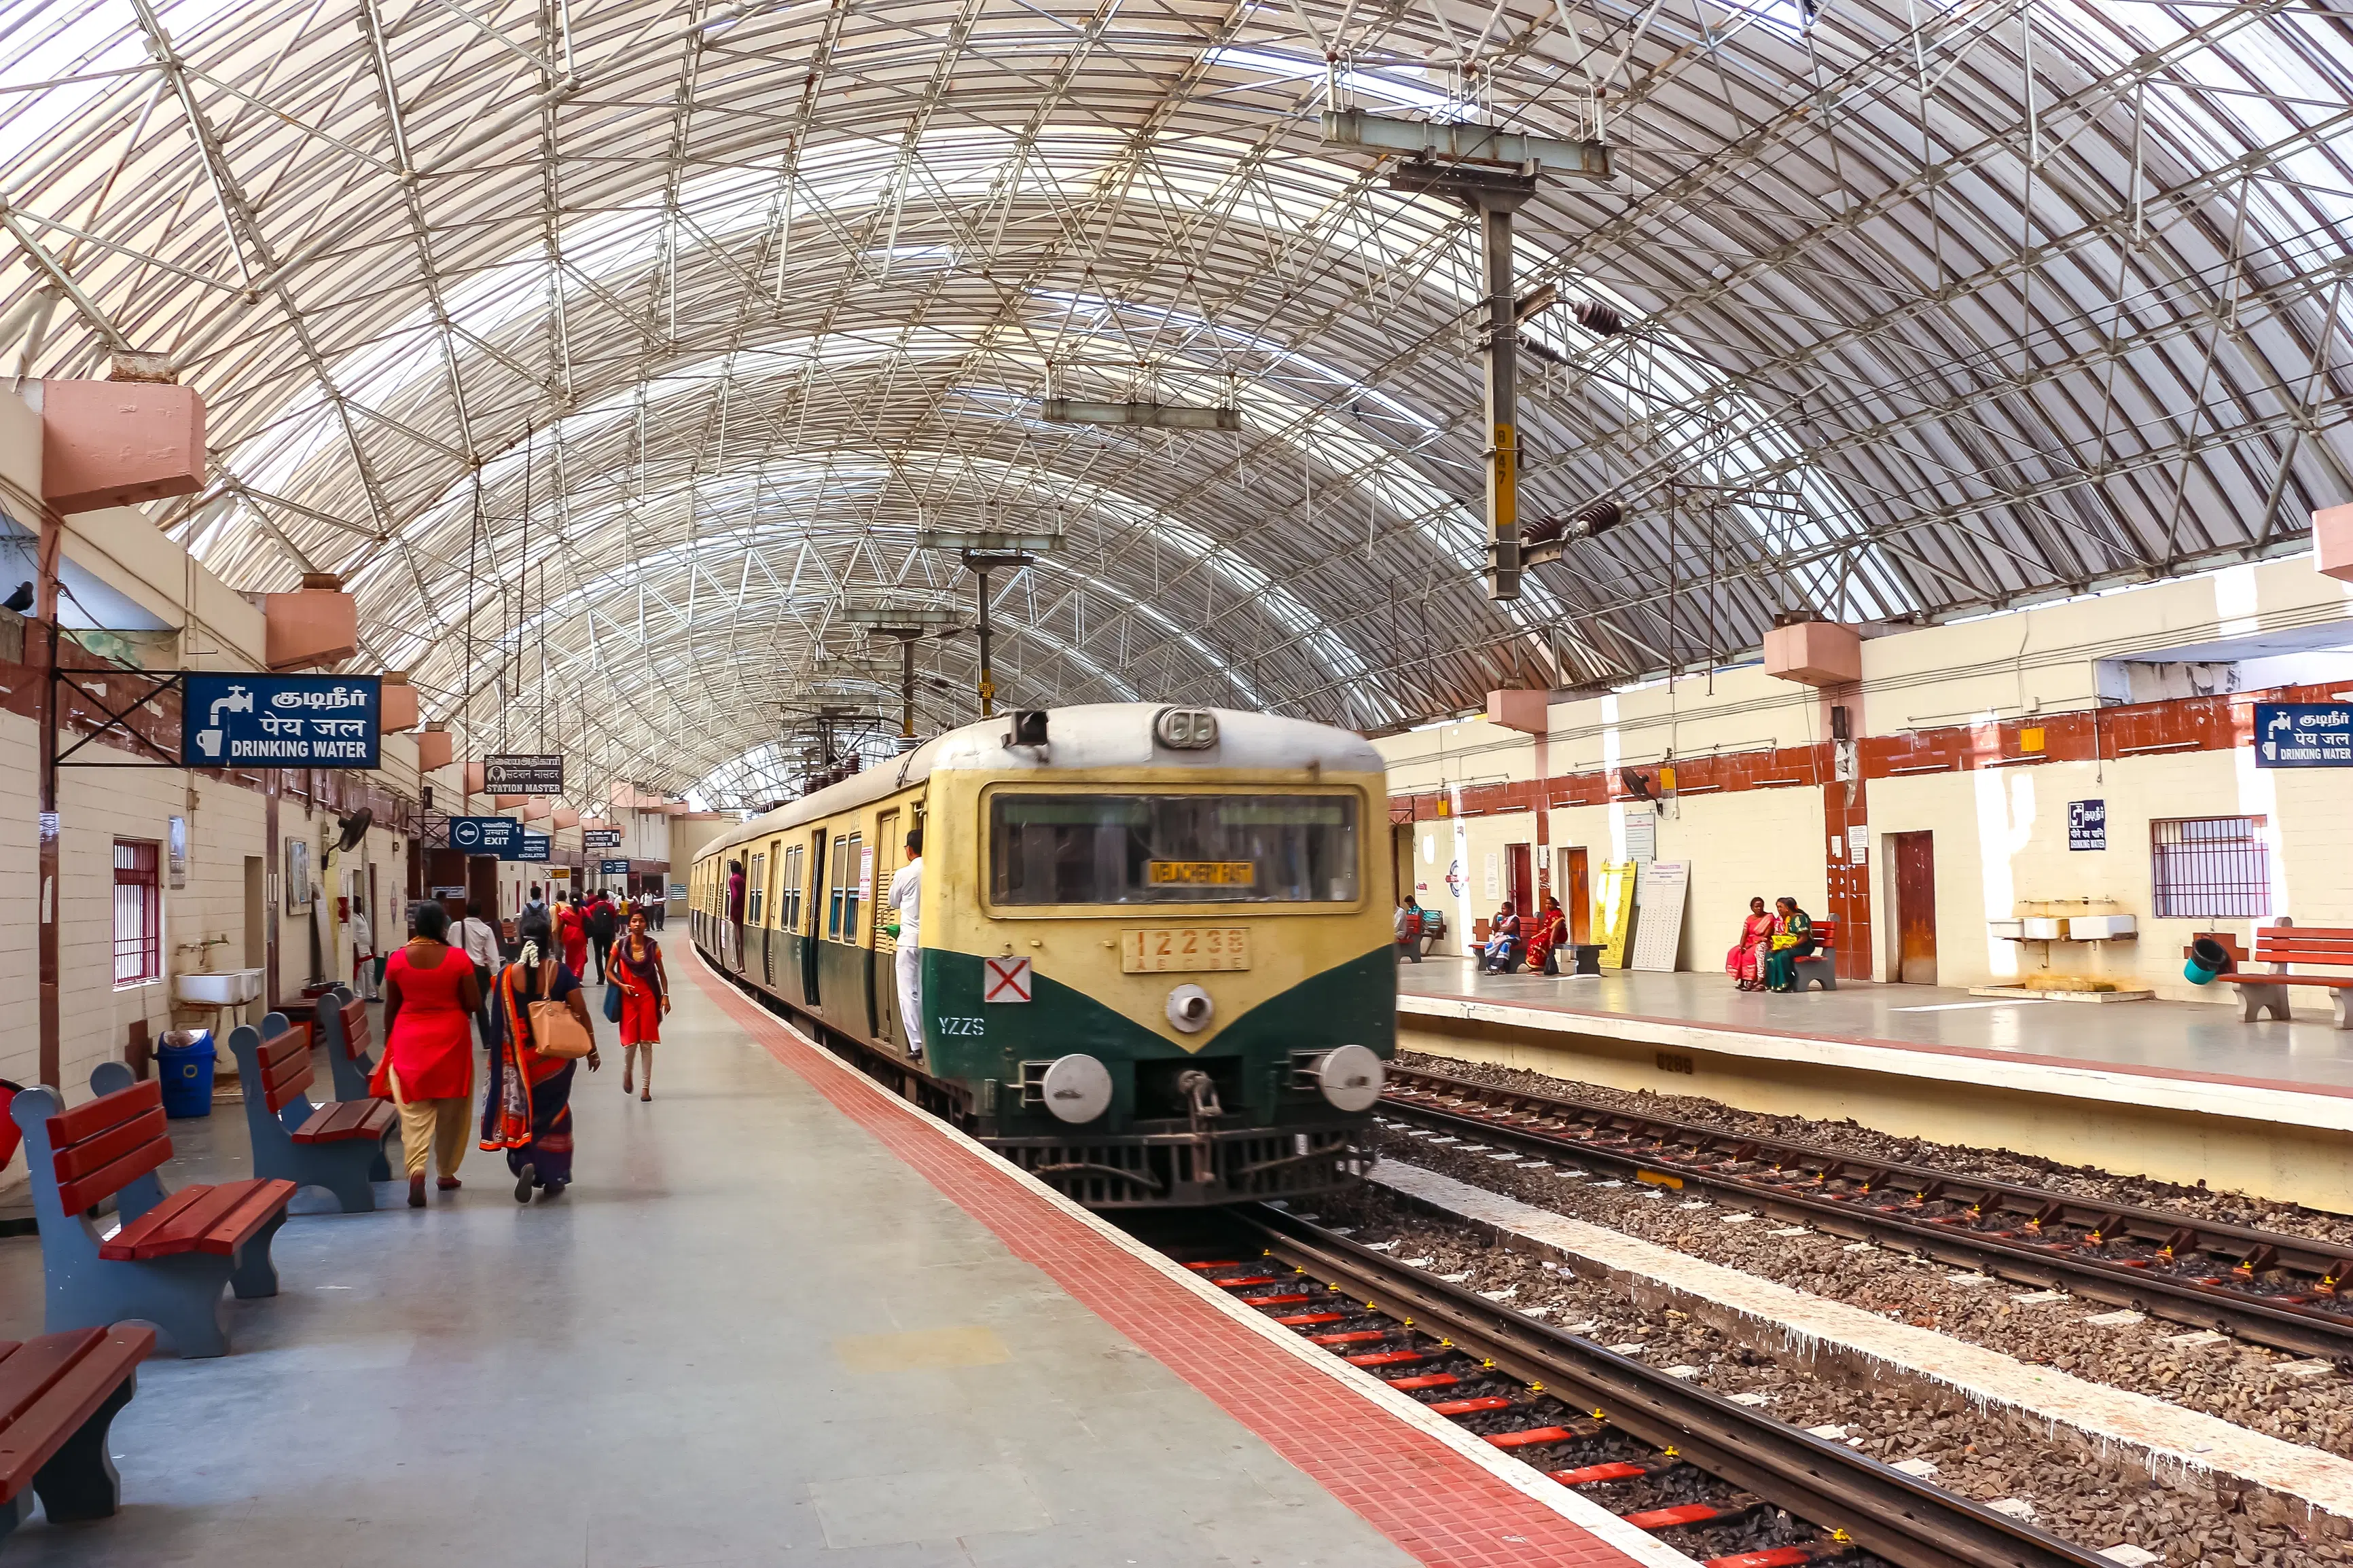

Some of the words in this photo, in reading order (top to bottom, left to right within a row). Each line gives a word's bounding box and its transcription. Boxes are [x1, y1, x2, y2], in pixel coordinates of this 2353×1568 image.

[271, 687, 367, 710] குடிநீர்
[258, 710, 304, 736] पेय
[310, 718, 367, 737] जल
[2299, 710, 2350, 727] குடிநீர்
[2293, 727, 2318, 746] पेय
[2320, 733, 2350, 746] जल
[231, 740, 308, 757] DRINKING
[312, 741, 367, 758] WATER
[2280, 748, 2322, 760] DRINKING
[2322, 748, 2352, 760] WATER
[486, 784, 523, 792] STATION
[525, 784, 560, 792] MASTER
[484, 837, 509, 845] EXIT
[938, 1017, 984, 1035] YZZS
